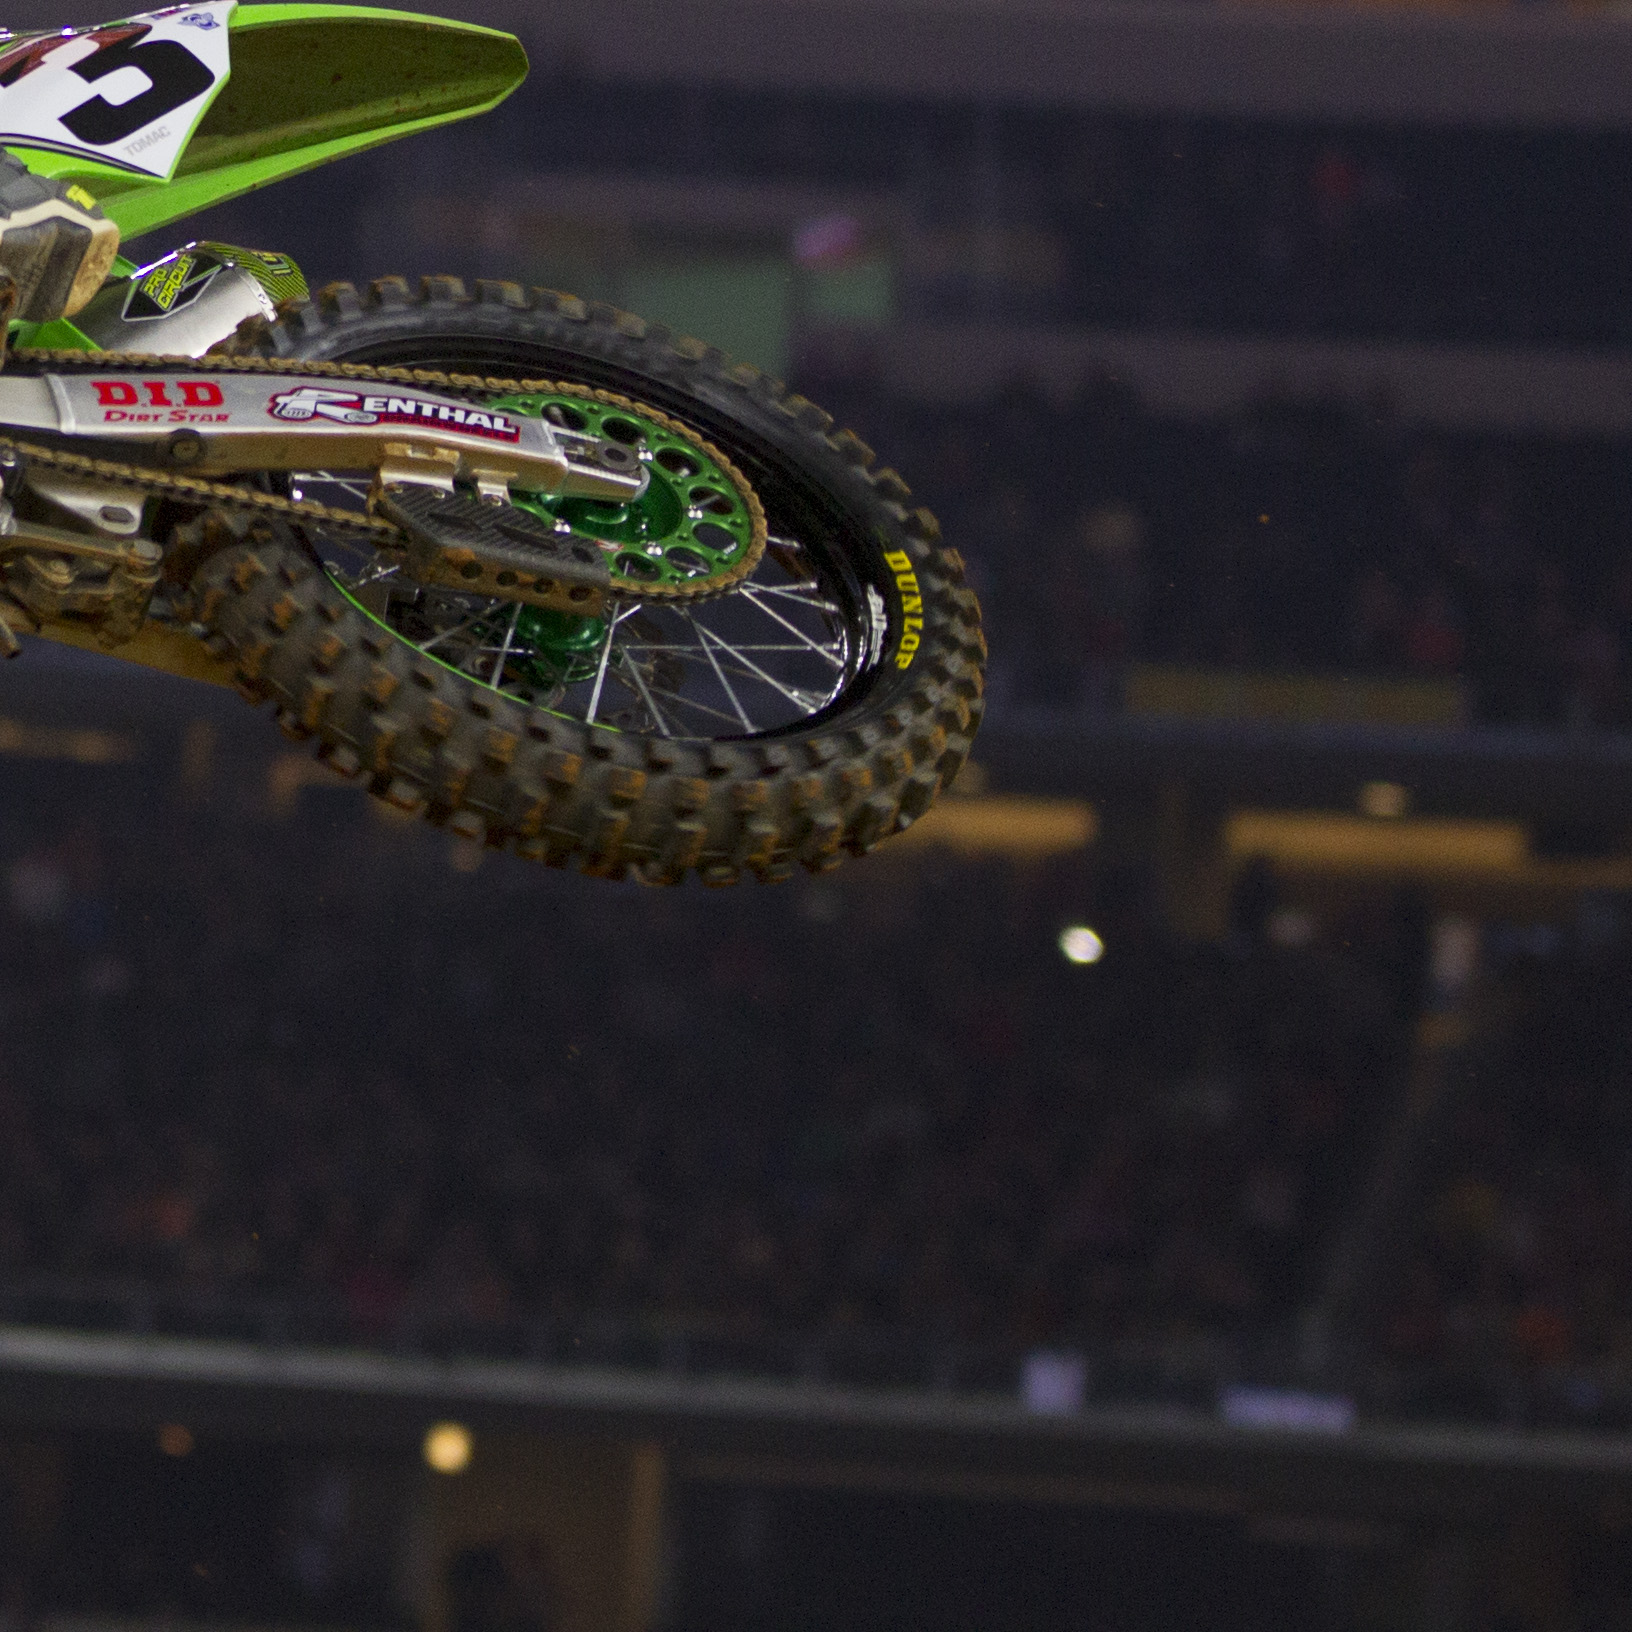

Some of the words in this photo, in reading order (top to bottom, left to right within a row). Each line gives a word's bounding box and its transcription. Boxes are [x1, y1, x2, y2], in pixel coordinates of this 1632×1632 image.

[123, 125, 172, 157] TOMAC
[143, 267, 169, 297] PRO
[156, 253, 195, 311] CIRCUIT
[883, 548, 924, 671] DUNLOP
